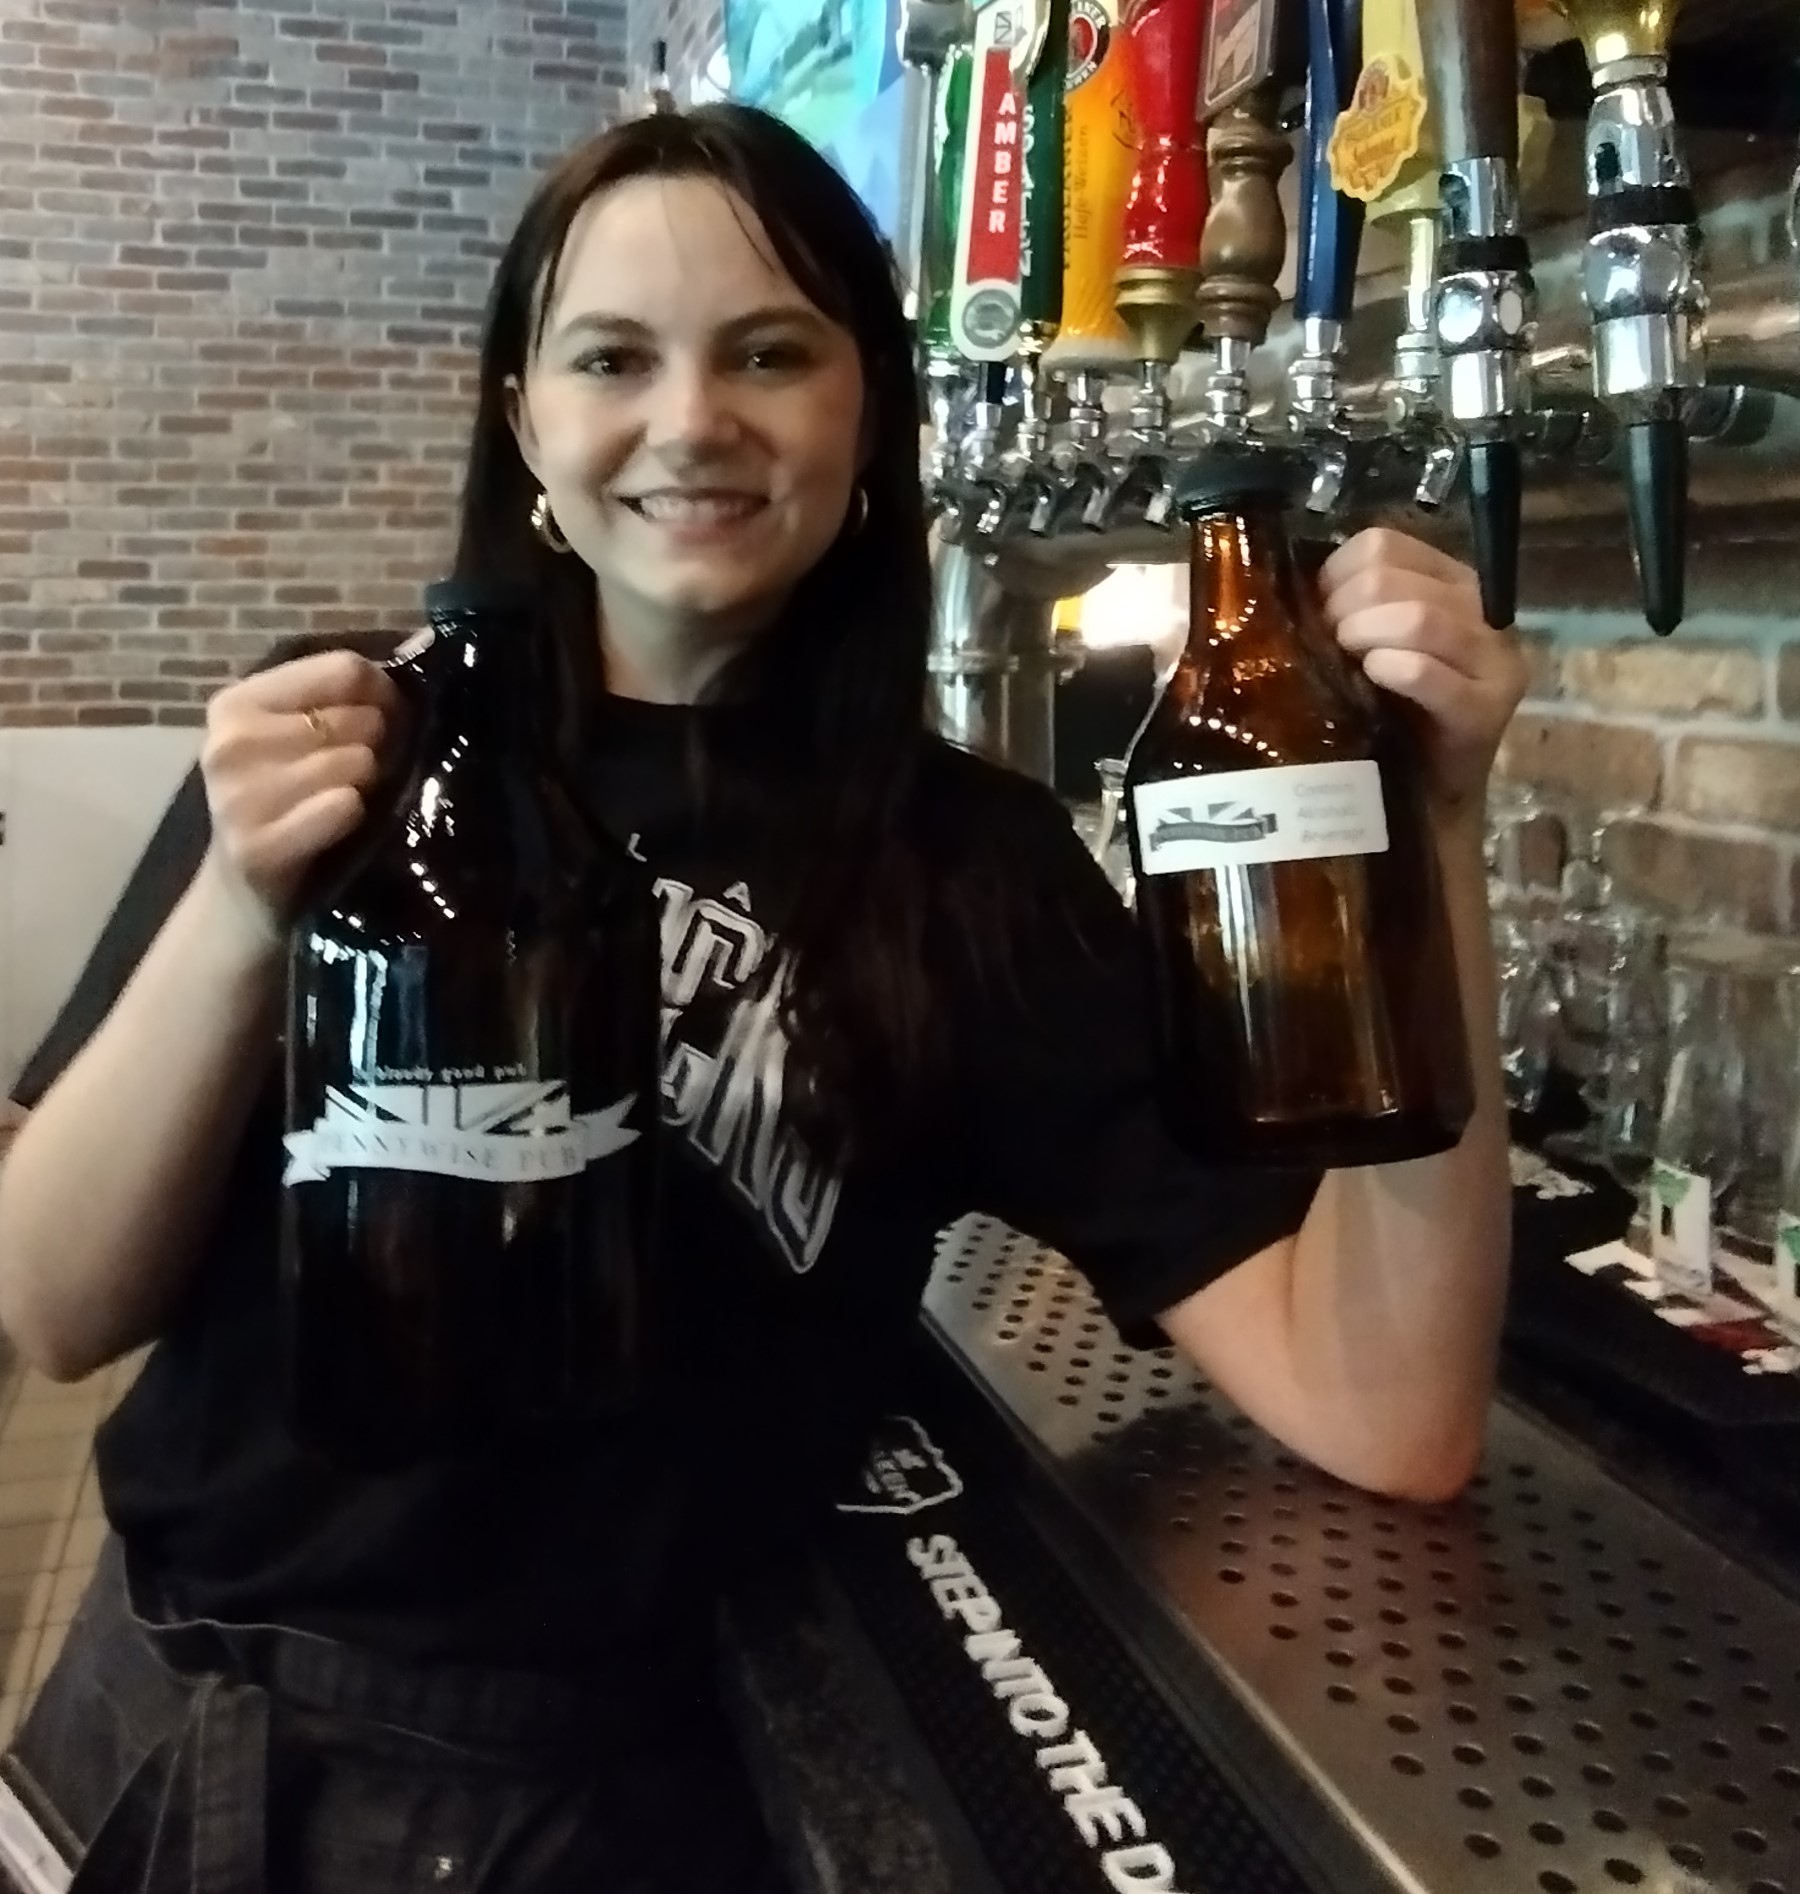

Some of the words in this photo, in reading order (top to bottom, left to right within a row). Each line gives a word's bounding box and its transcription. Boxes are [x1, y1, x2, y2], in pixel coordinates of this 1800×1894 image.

[989, 92, 1017, 233] AMBER
[906, 1535, 1001, 1632] STEP
[964, 1628, 1069, 1738] INTO
[1036, 1728, 1147, 1847] THE
